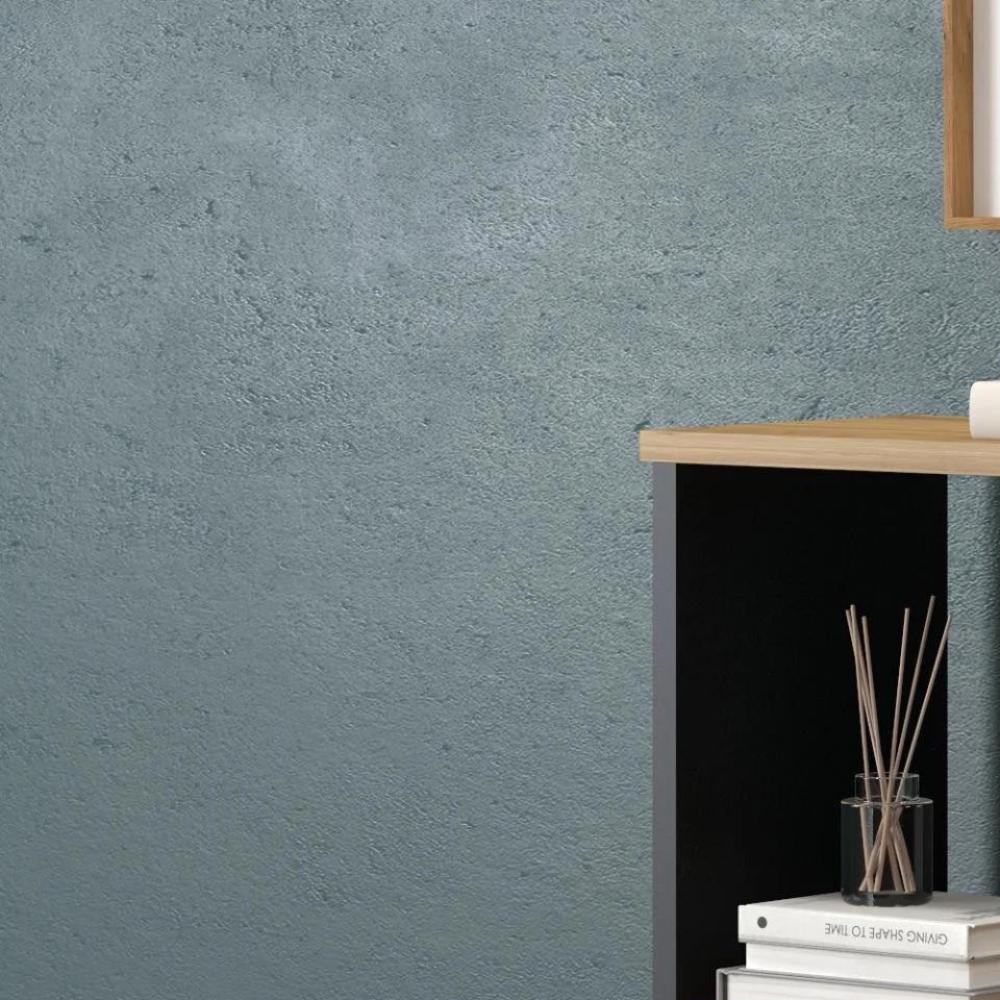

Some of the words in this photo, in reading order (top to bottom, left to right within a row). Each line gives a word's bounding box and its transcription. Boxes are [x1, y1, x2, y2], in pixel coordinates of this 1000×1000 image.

[824, 923, 849, 937] TIME
[851, 926, 867, 939] TO
[869, 927, 904, 942] SHAPE
[906, 930, 949, 946] GIVING
